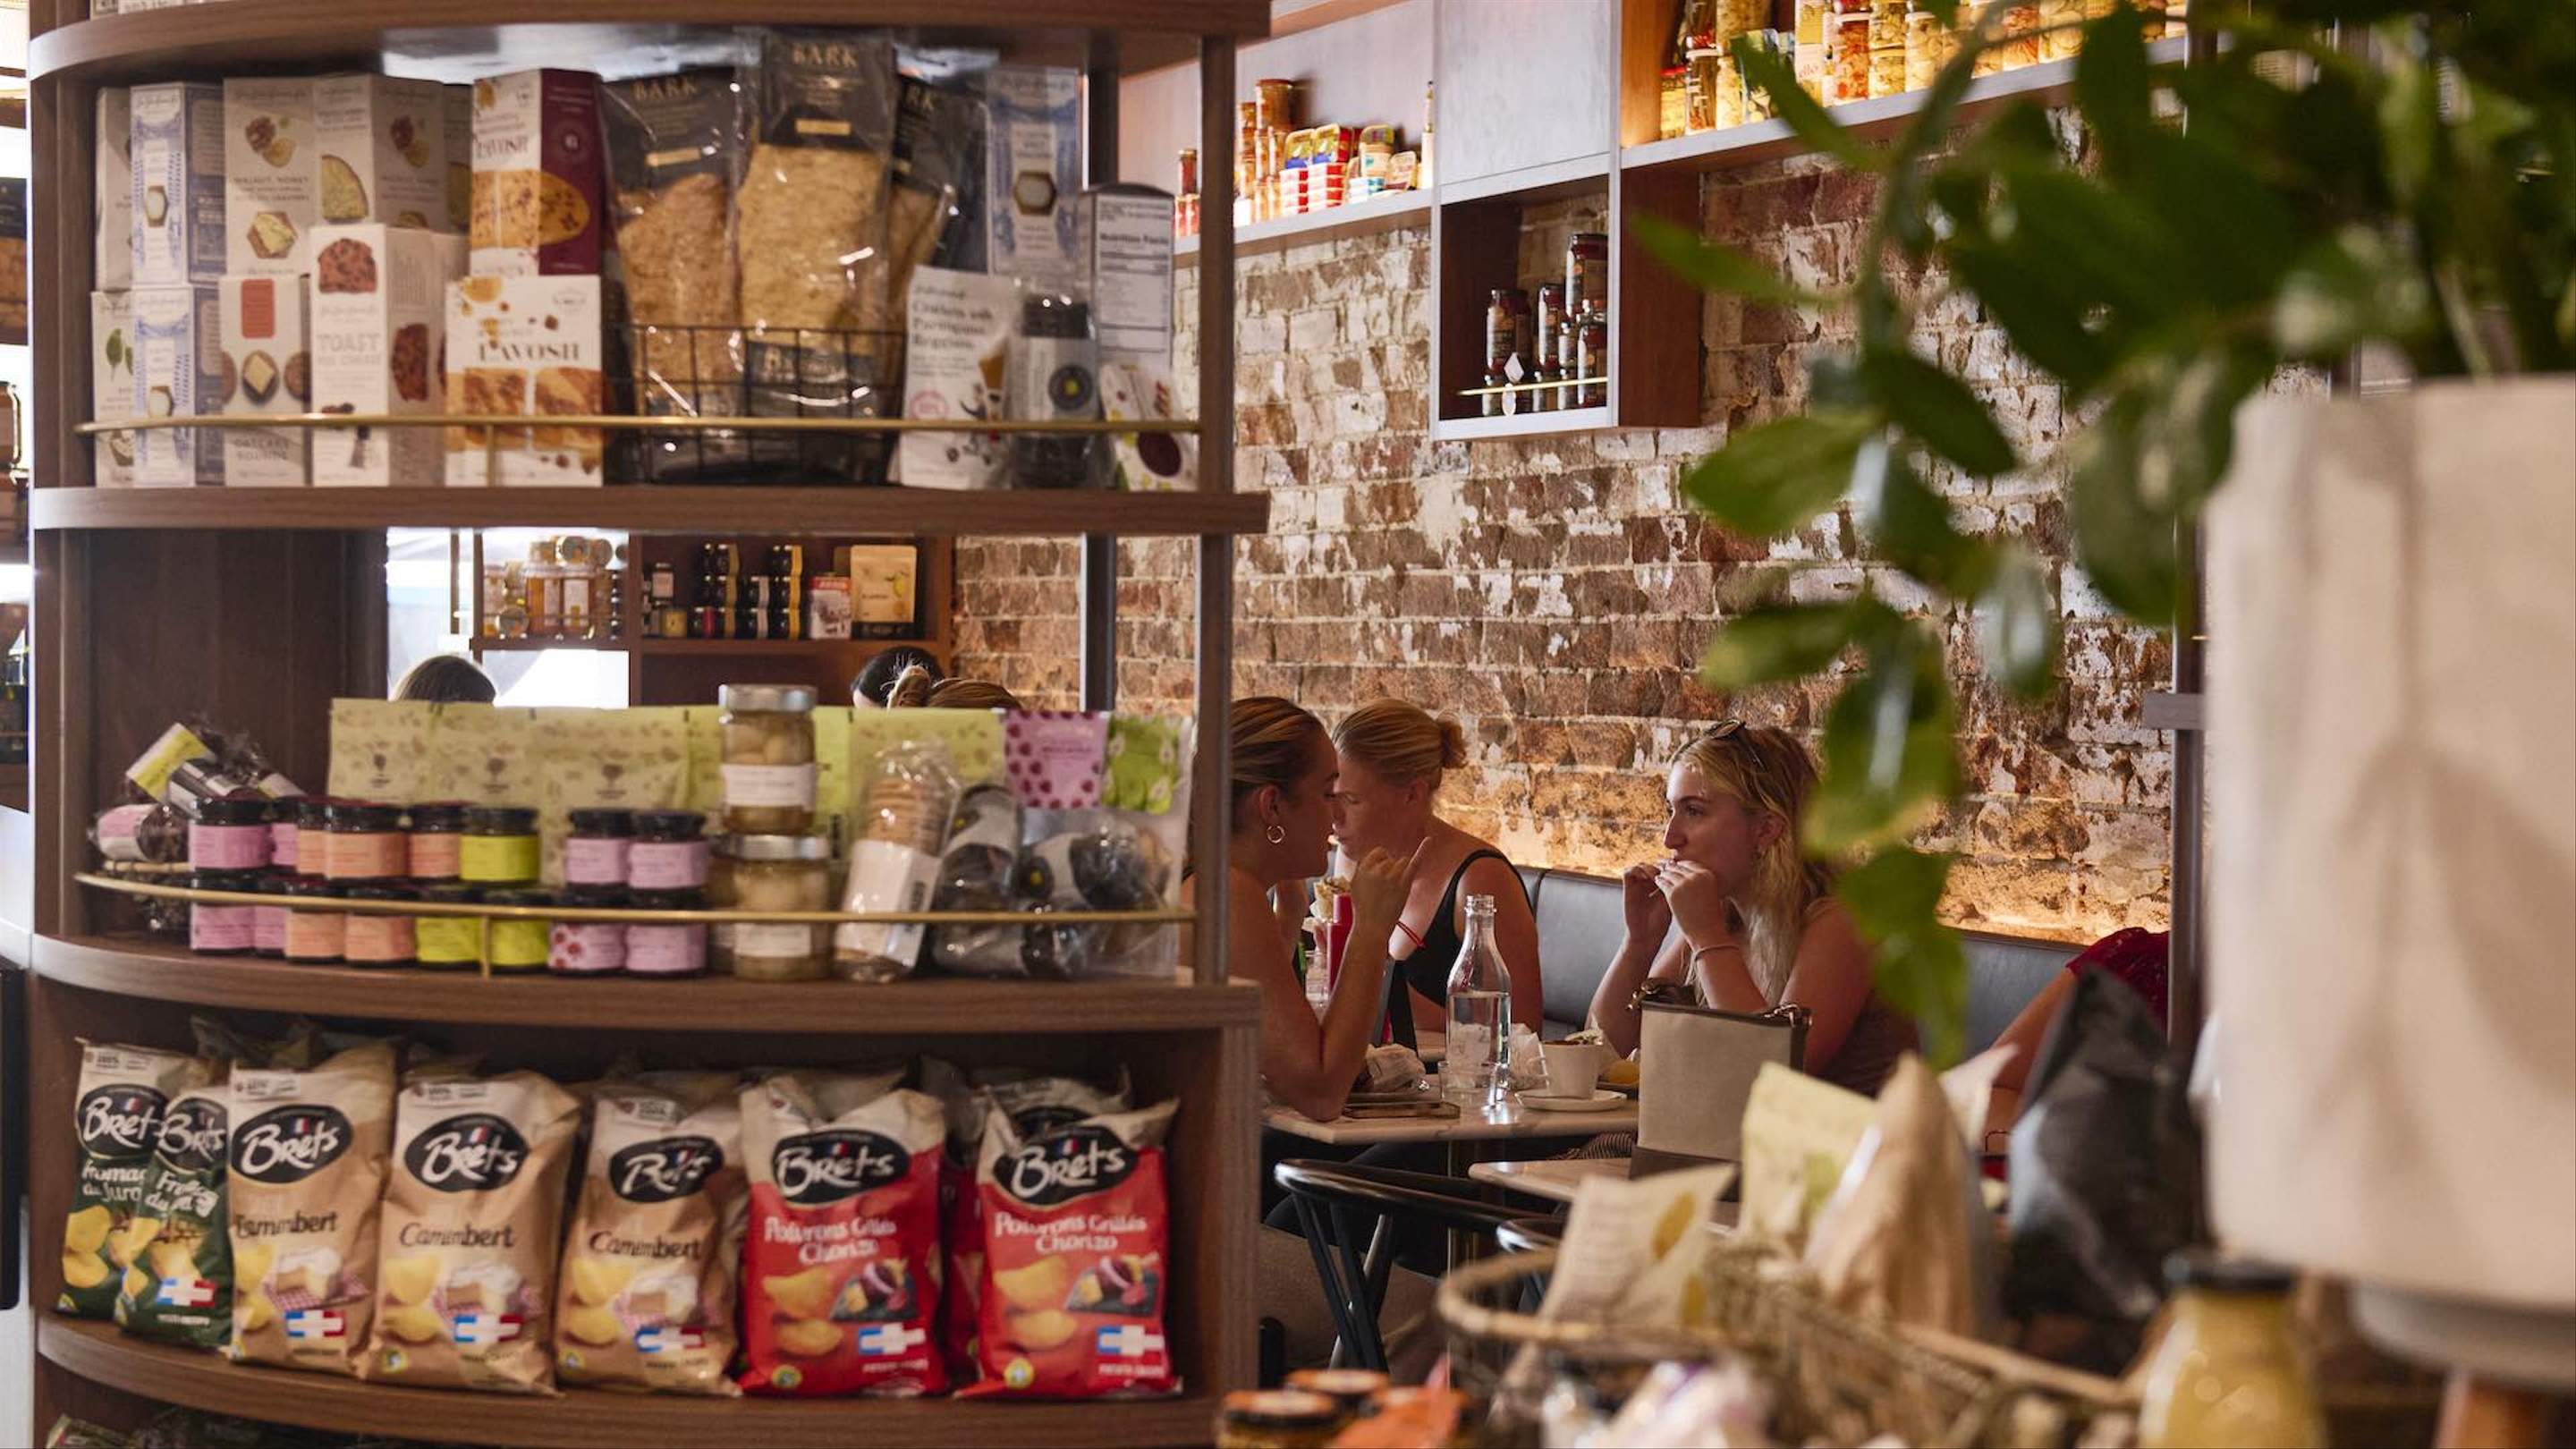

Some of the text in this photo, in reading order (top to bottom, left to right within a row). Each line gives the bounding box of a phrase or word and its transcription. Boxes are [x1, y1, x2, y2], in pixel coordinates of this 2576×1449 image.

[792, 42, 860, 69] BARK
[631, 76, 699, 101] BARK
[479, 343, 580, 361] LAVOSH
[84, 1095, 160, 1149] Bret
[157, 1113, 226, 1162] Brts
[241, 1120, 341, 1175] Brets
[421, 1131, 520, 1183] Brets
[776, 1145, 896, 1198] Brets
[1011, 1139, 1126, 1199] Brets
[621, 1152, 712, 1195] Bts
[234, 1209, 338, 1240] Cammbert
